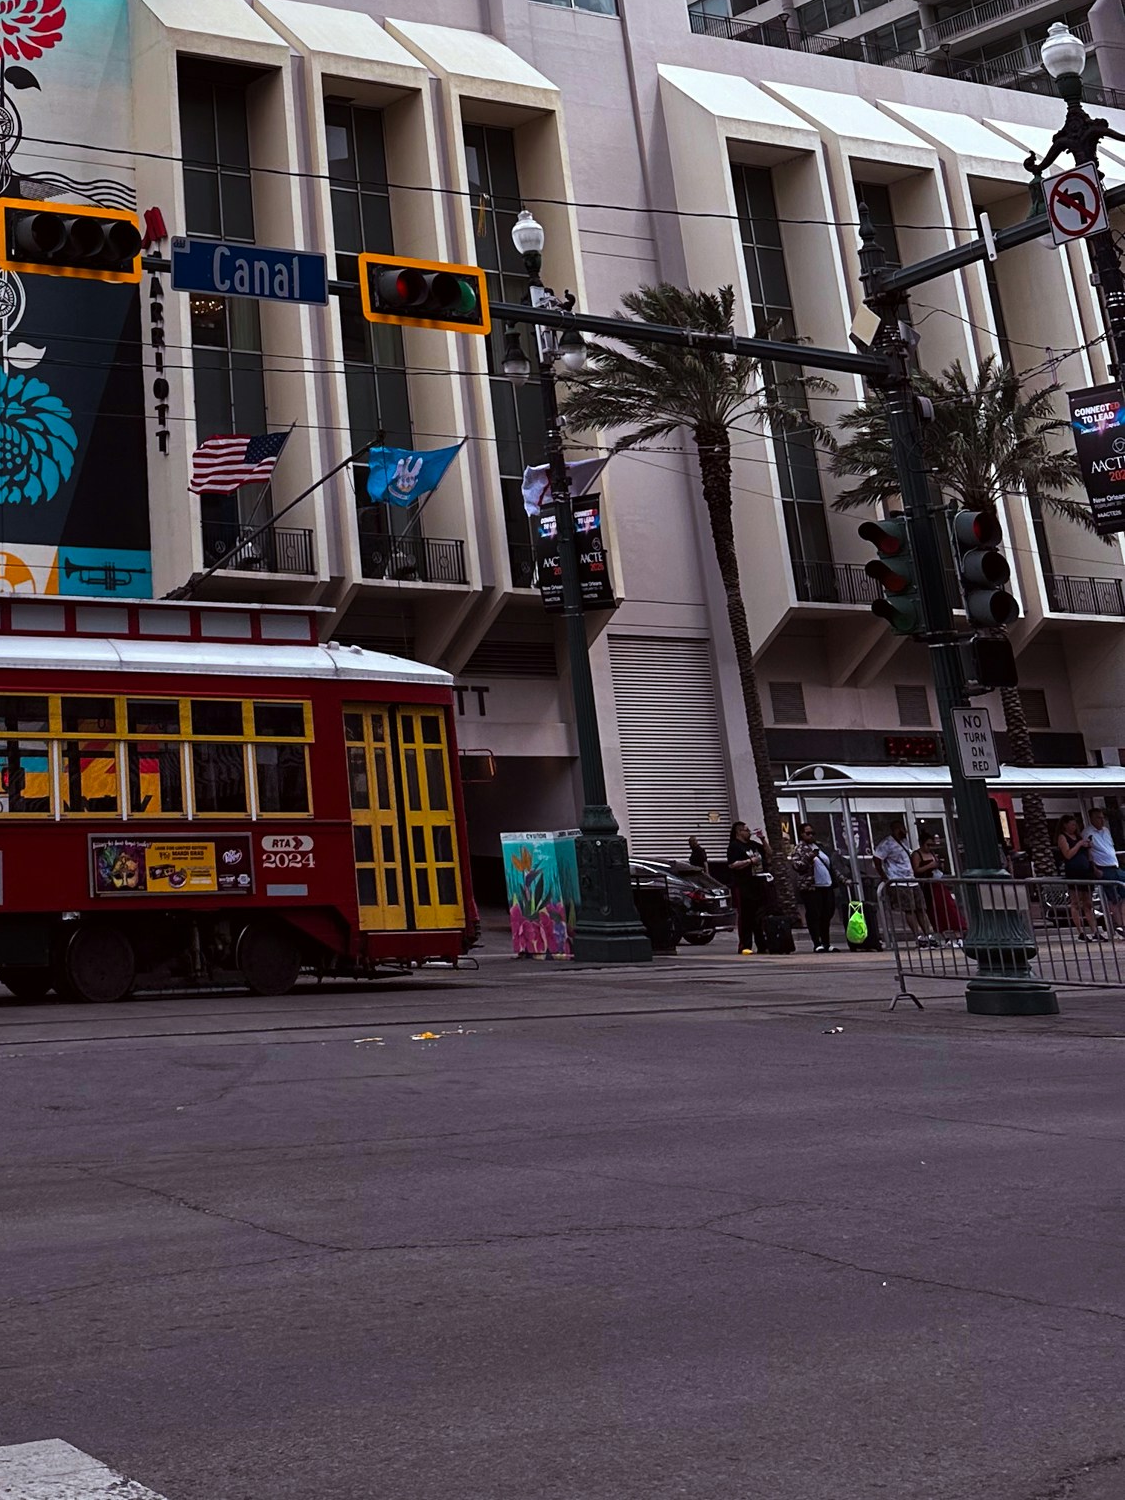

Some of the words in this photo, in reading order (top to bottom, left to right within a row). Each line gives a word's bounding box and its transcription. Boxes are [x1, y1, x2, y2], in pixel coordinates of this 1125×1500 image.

[212, 245, 300, 299] Canal
[1074, 401, 1121, 418] CONNECTED
[1081, 416, 1094, 425] TO
[1094, 411, 1115, 422] LEAD
[580, 552, 603, 564] AACTE
[962, 715, 982, 729] NO
[963, 732, 987, 743] TURN
[971, 746, 985, 757] ON
[972, 761, 990, 771] RED
[272, 839, 291, 849] RTA
[262, 852, 315, 869] 2024
